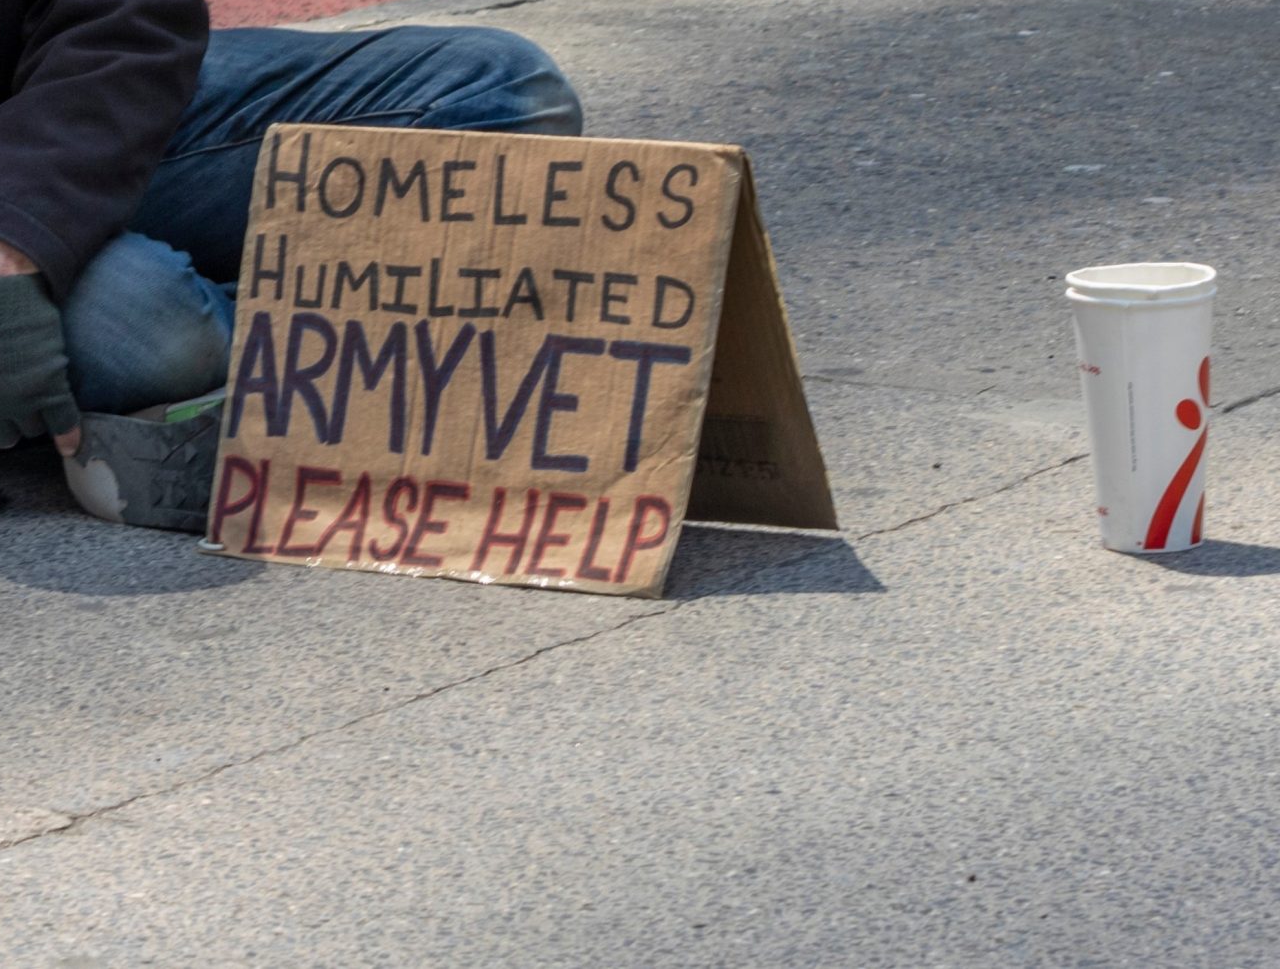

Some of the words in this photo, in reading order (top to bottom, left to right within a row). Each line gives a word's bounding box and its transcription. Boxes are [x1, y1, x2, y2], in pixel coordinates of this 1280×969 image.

[264, 132, 699, 232] HOMELESS
[250, 233, 697, 331] HUMILIATED
[211, 454, 470, 568] PLEASE
[471, 487, 673, 584] HELP
